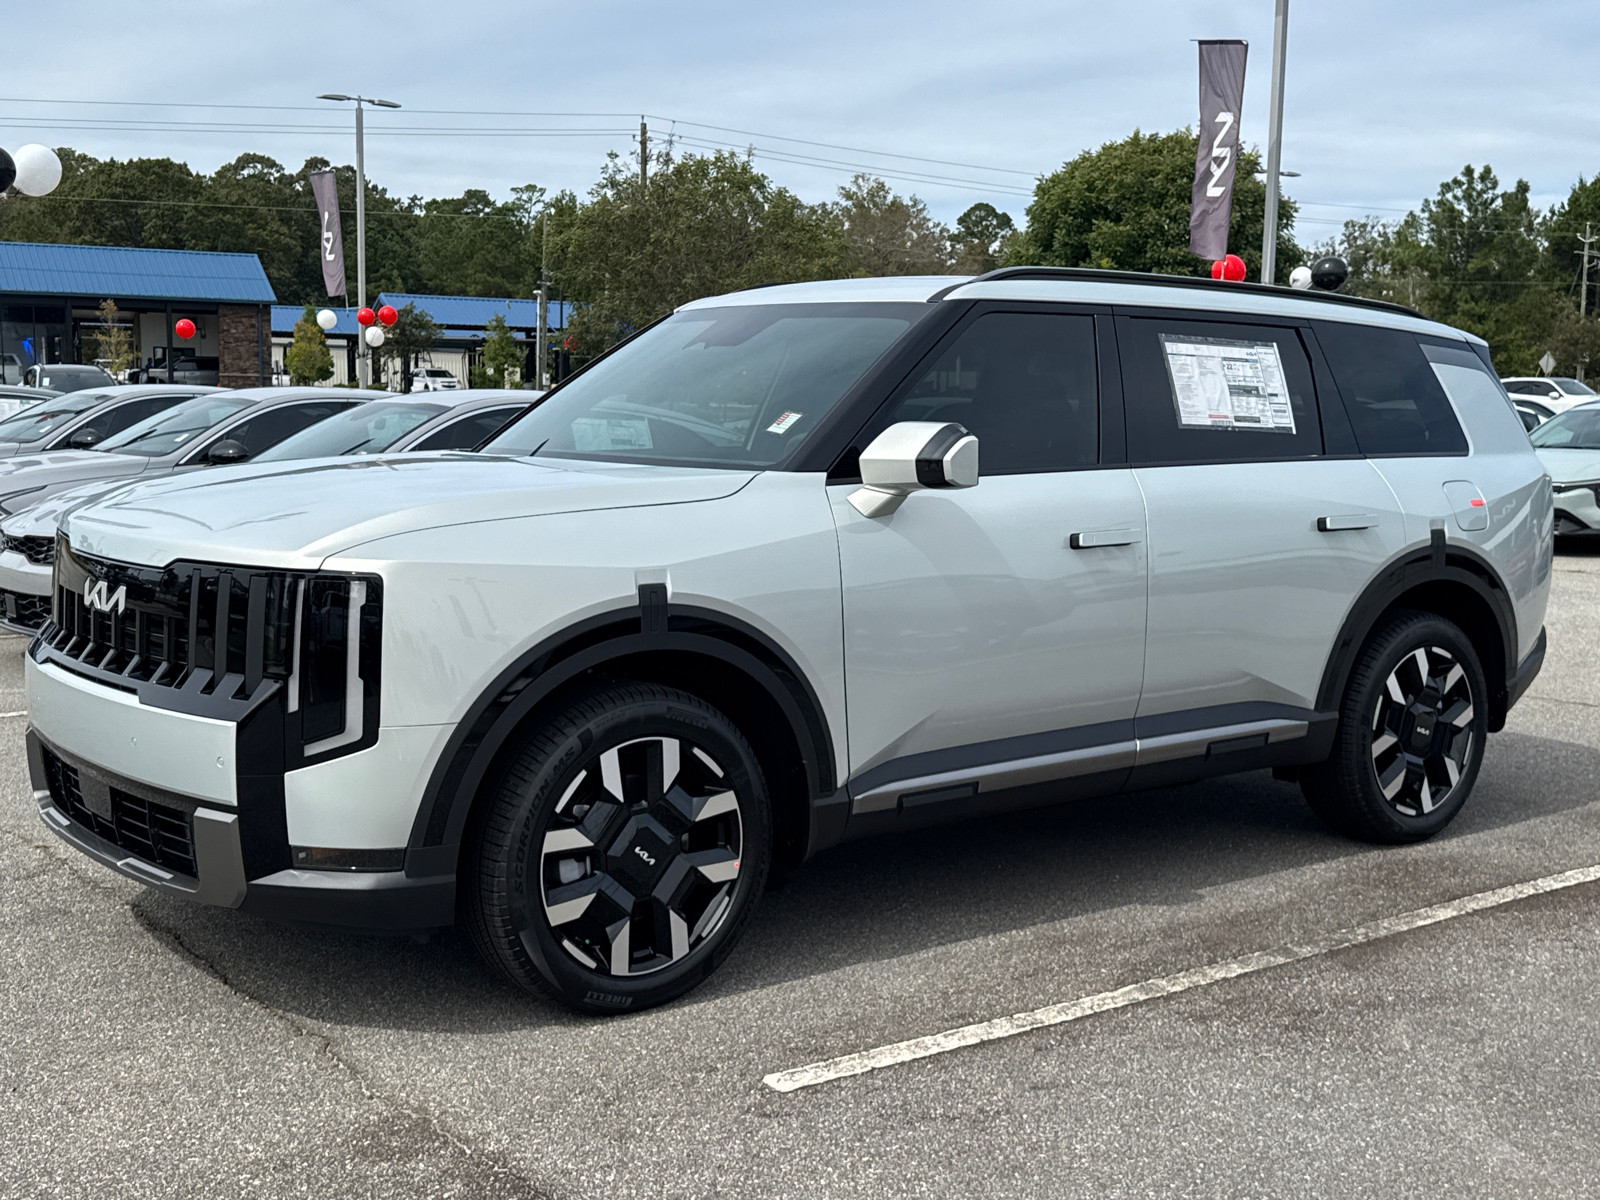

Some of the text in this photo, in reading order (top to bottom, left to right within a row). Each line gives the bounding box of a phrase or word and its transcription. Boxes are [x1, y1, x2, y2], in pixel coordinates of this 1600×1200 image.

[84, 577, 126, 616] KIA
[514, 778, 551, 894] SCORPION
[634, 846, 656, 866] KIA
